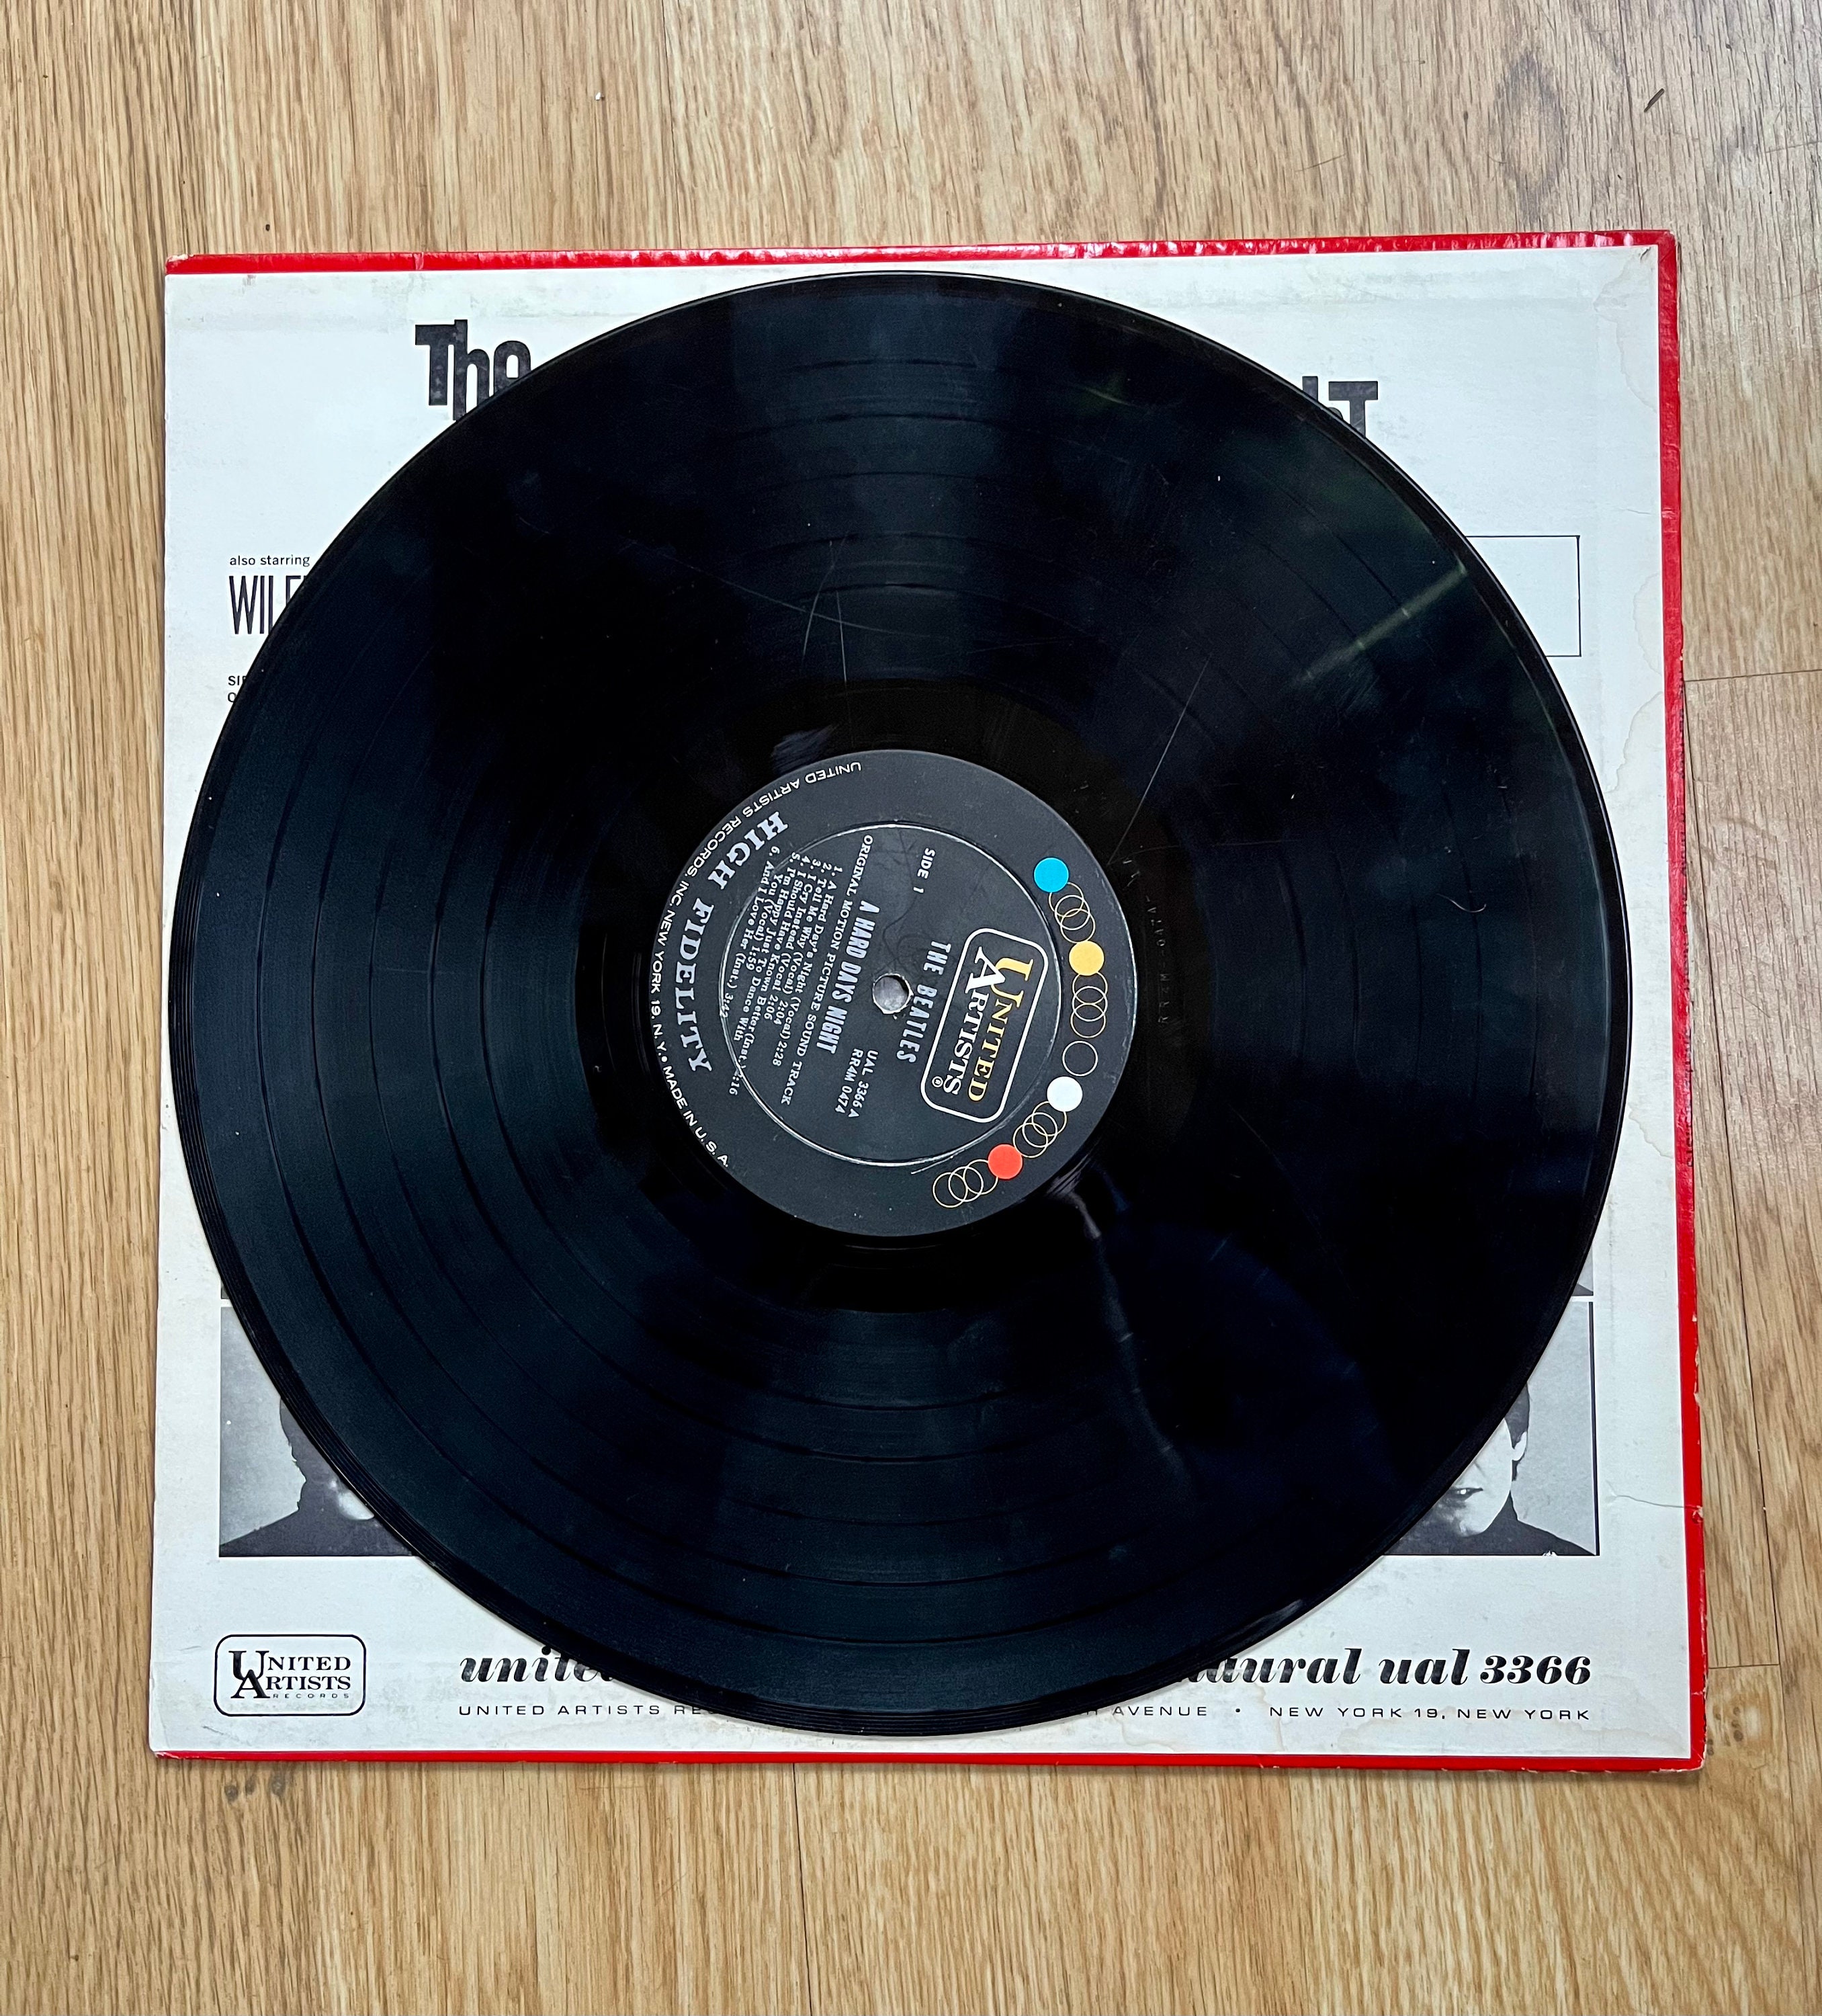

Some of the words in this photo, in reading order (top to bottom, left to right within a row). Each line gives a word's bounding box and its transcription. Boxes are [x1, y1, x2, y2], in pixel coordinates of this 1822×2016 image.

[230, 555, 255, 566] also
[260, 554, 310, 567] starring
[806, 762, 861, 784] UNITED
[743, 779, 799, 818] ARTISTS
[708, 811, 788, 890] HIGH
[769, 846, 780, 856] 6.
[789, 852, 801, 863] 5.
[799, 855, 811, 866] 4.
[810, 859, 822, 870] 3.
[846, 835, 873, 896] ORIGINAL
[917, 847, 936, 879] SIDE
[761, 860, 775, 885] And
[783, 867, 796, 886] I'm
[797, 870, 807, 878] I
[807, 874, 817, 882] I
[820, 862, 832, 873] 2.
[831, 866, 843, 876] 1.
[768, 874, 783, 896] You
[783, 879, 804, 919] Should
[799, 883, 813, 905] Cry
[812, 878, 827, 902] Tell
[827, 880, 837, 890] A
[748, 896, 765, 926] Love
[753, 898, 775, 941] (Vocal)
[769, 888, 789, 926] Happy
[806, 905, 819, 922] Me
[818, 893, 834, 922] Hard
[859, 900, 880, 913] A
[658, 910, 676, 946] NEW
[740, 928, 754, 950] Her
[774, 920, 791, 950] Have
[785, 907, 807, 950] Instead
[796, 926, 812, 949] Why
[830, 899, 853, 950] MOTION
[846, 917, 875, 959] HARD
[761, 927, 777, 954] Just
[806, 924, 824, 958] Day's
[650, 950, 664, 993] YORK
[726, 953, 746, 989] (Inst.)
[746, 946, 761, 970] 1:59
[755, 958, 768, 973] To
[761, 953, 781, 992] Known
[772, 953, 792, 991] (Vocal
[923, 941, 951, 975] THE
[675, 898, 715, 1072] FIDELITY
[782, 952, 804, 995] (Vocal)
[795, 961, 813, 994] Night
[810, 952, 836, 1011] PICTURE
[832, 961, 861, 1003] DAYS
[743, 976, 762, 1013] Dance
[764, 994, 779, 1020] 2:06
[748, 995, 767, 1032] Better
[773, 1000, 789, 1025] 2:04
[779, 997, 801, 1040] (Vocal)
[896, 984, 938, 1062] BEATLES
[943, 946, 1006, 1095] ARTISTS
[734, 1017, 749, 1041] With
[797, 1013, 817, 1056] SOUND
[816, 1005, 848, 1054] NIGHT
[968, 957, 1034, 1101] UNITED
[772, 1040, 787, 1066] 2:28
[844, 1048, 864, 1082] RR4M
[861, 1050, 879, 1076] UAL
[663, 1065, 689, 1109] MADE
[781, 1061, 803, 1105] TRACK
[853, 1081, 869, 1108] 3366
[835, 1085, 853, 1114] 0474
[683, 1110, 698, 1127] IN
[228, 1650, 351, 1680] UNITED
[460, 1646, 613, 1683] unite
[1186, 1648, 1362, 1685] aural
[1378, 1648, 1470, 1685] ual
[1480, 1655, 1591, 1685] 3366
[230, 1669, 351, 1699] ARTISTS
[460, 1706, 545, 1715] UNITED
[558, 1705, 660, 1715] ARTISTS
[1113, 1706, 1208, 1717] AVENUE
[1270, 1707, 1323, 1718] NEW
[1338, 1708, 1402, 1718] YORK
[1414, 1708, 1445, 1719] 19,
[1458, 1709, 1511, 1719] NEW
[1524, 1710, 1590, 1720] YORK
